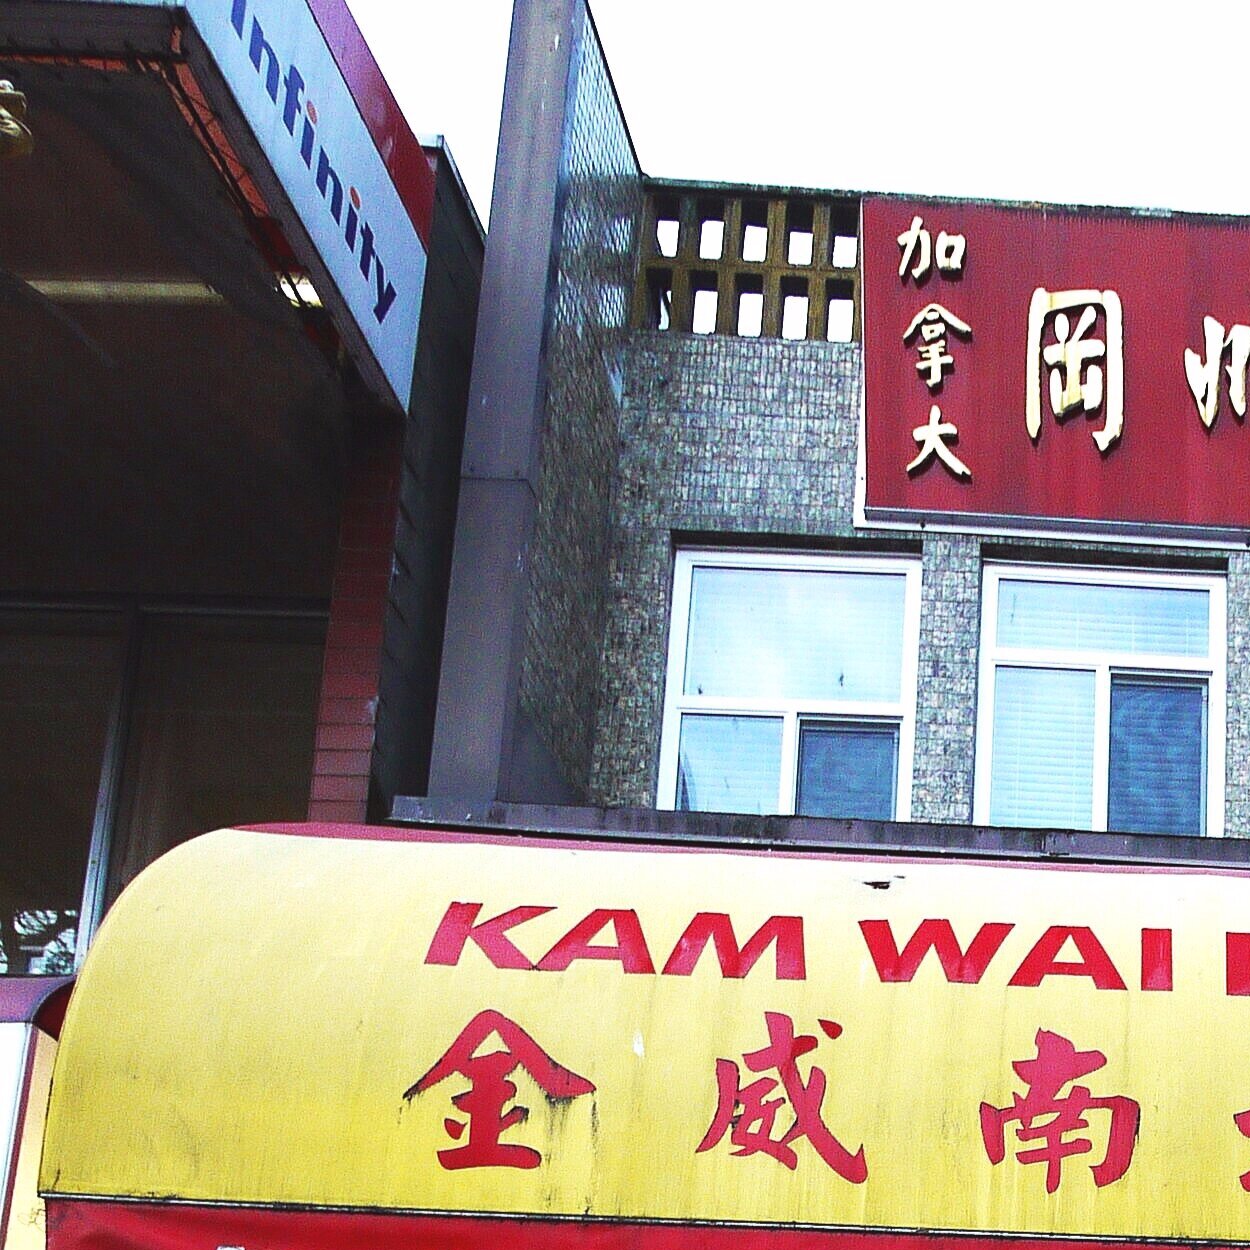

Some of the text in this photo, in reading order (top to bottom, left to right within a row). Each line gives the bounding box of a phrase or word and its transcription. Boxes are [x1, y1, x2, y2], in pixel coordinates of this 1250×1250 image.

[897, 216, 972, 480] 加拿大
[424, 901, 806, 980] KAM
[859, 919, 1173, 991] WAI
